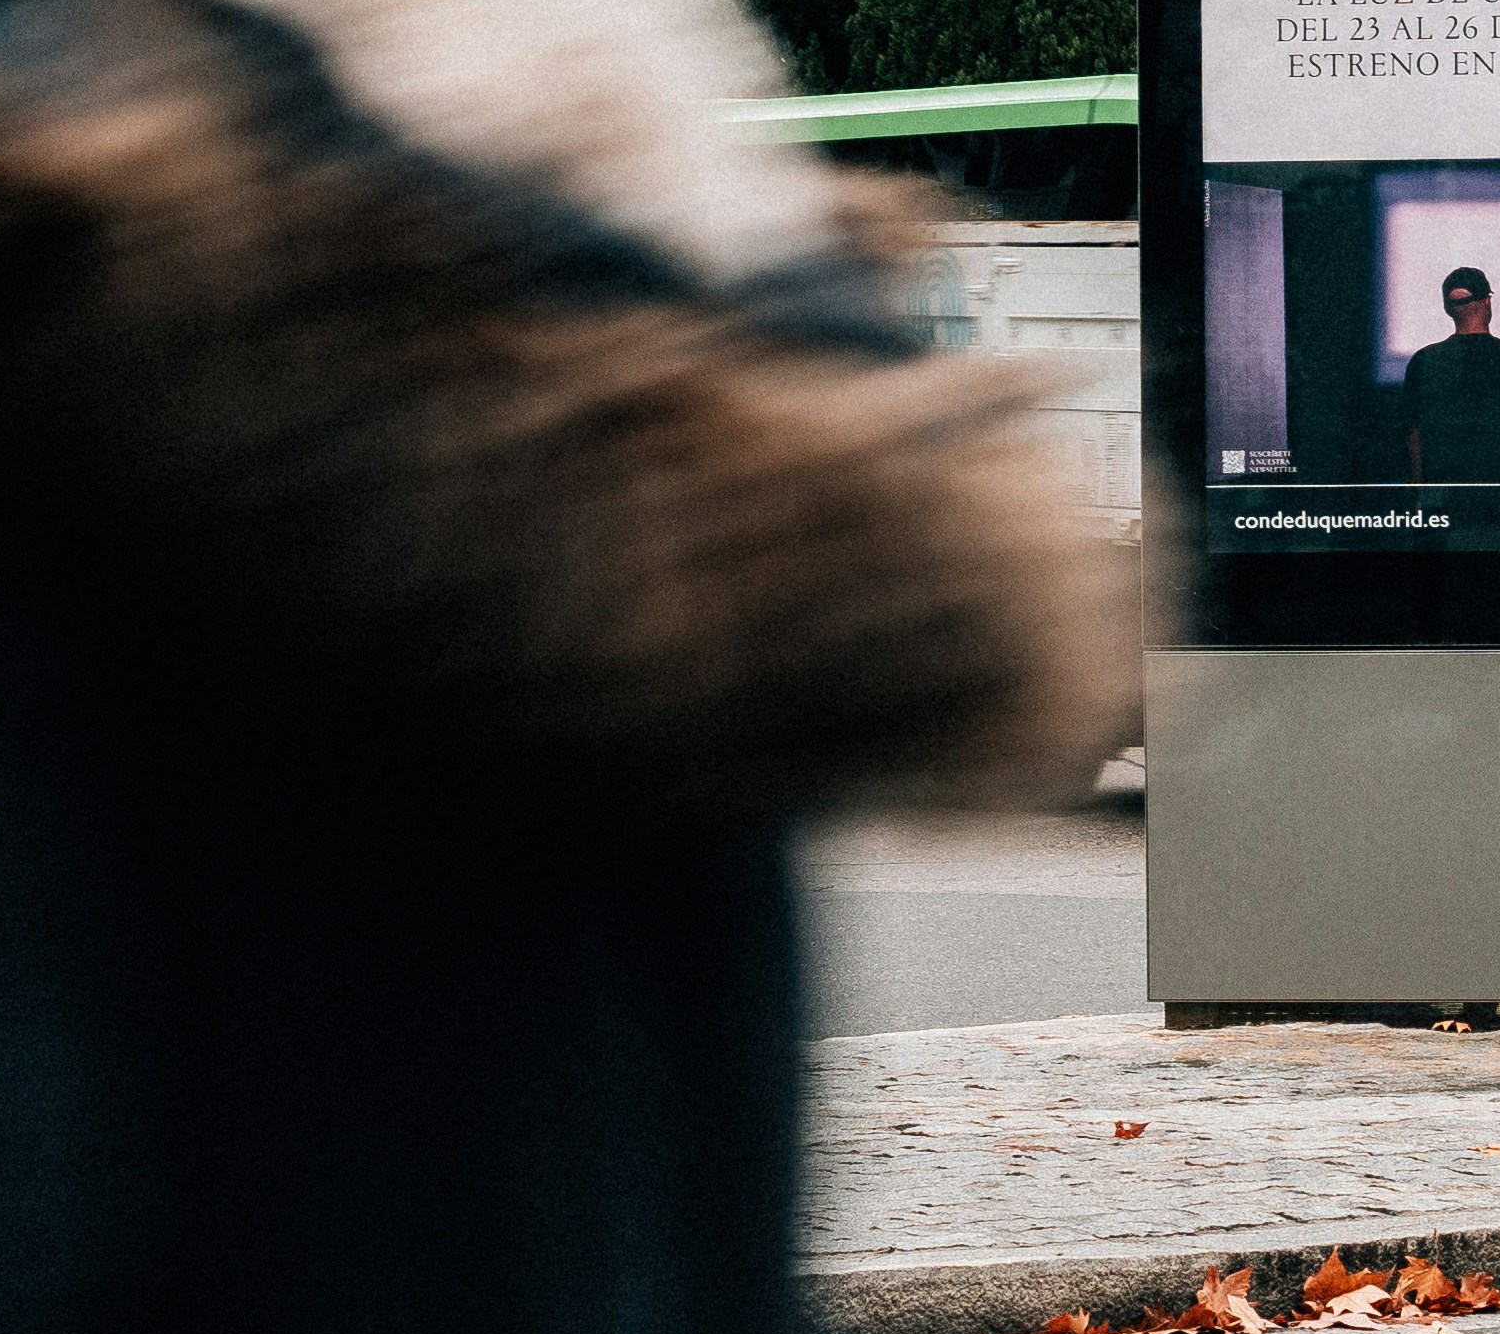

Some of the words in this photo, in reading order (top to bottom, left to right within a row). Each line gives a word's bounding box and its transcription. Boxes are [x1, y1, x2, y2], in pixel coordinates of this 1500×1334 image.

[1276, 17, 1338, 42] DEL
[1349, 16, 1380, 41] 23
[1392, 16, 1433, 41] AL
[1445, 15, 1478, 40] 26
[1288, 51, 1440, 78] ESTRENO
[1453, 51, 1495, 76] EN
[1234, 509, 1450, 534] condeduquemadrid.es
